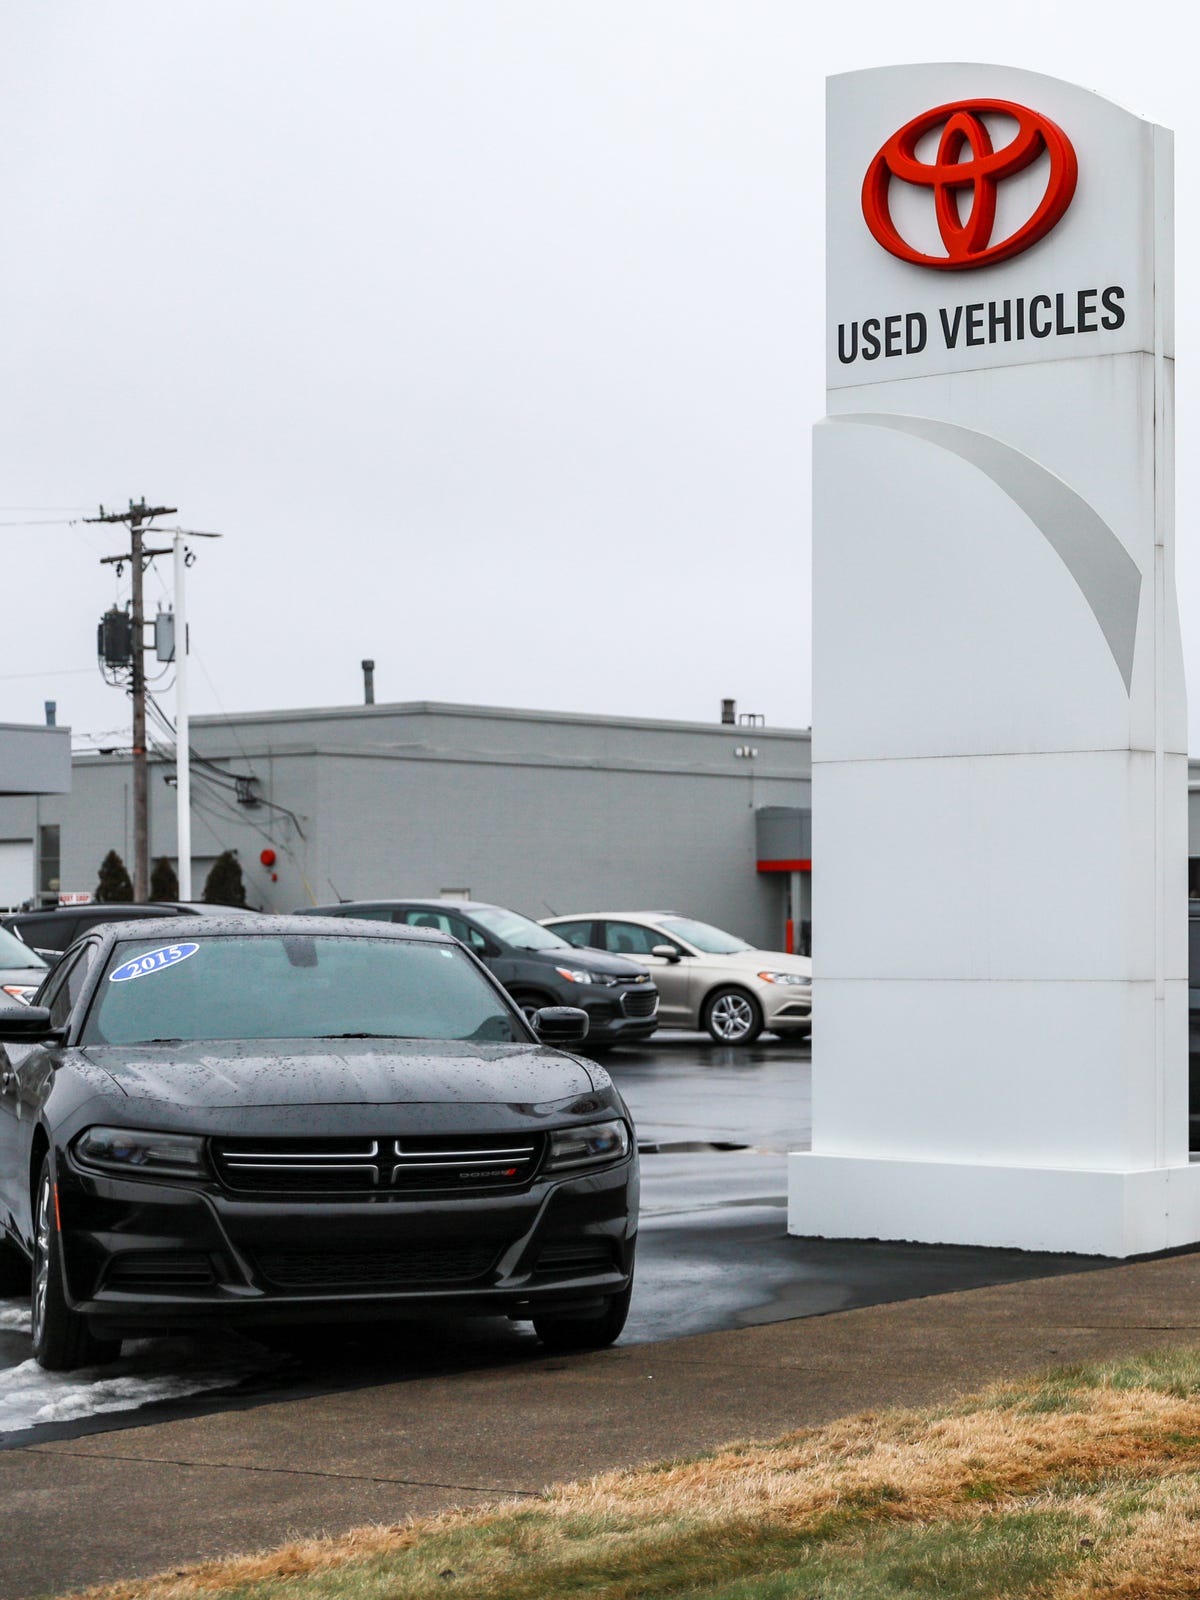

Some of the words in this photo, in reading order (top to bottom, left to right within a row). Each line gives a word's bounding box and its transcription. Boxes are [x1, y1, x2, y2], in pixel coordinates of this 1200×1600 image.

[837, 311, 928, 364] USED
[938, 285, 1126, 350] VEHICLES
[127, 946, 182, 977] 2015
